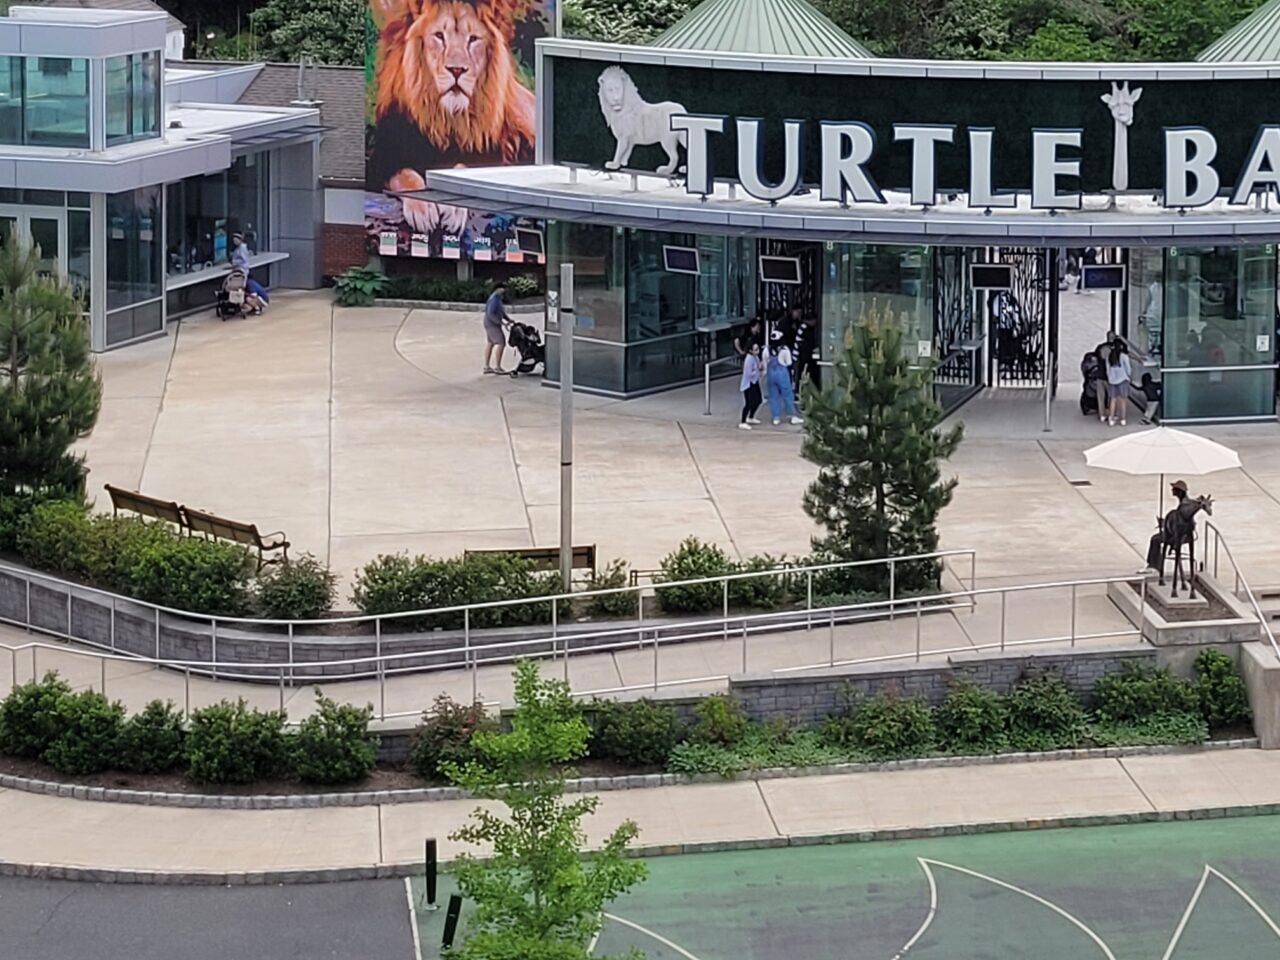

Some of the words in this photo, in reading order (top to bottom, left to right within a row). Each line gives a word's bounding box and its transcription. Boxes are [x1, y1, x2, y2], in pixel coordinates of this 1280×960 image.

[669, 113, 1084, 211] TURTLE
[826, 240, 834, 250] 8
[1265, 244, 1272, 254] 5
[1170, 246, 1177, 256] 6
